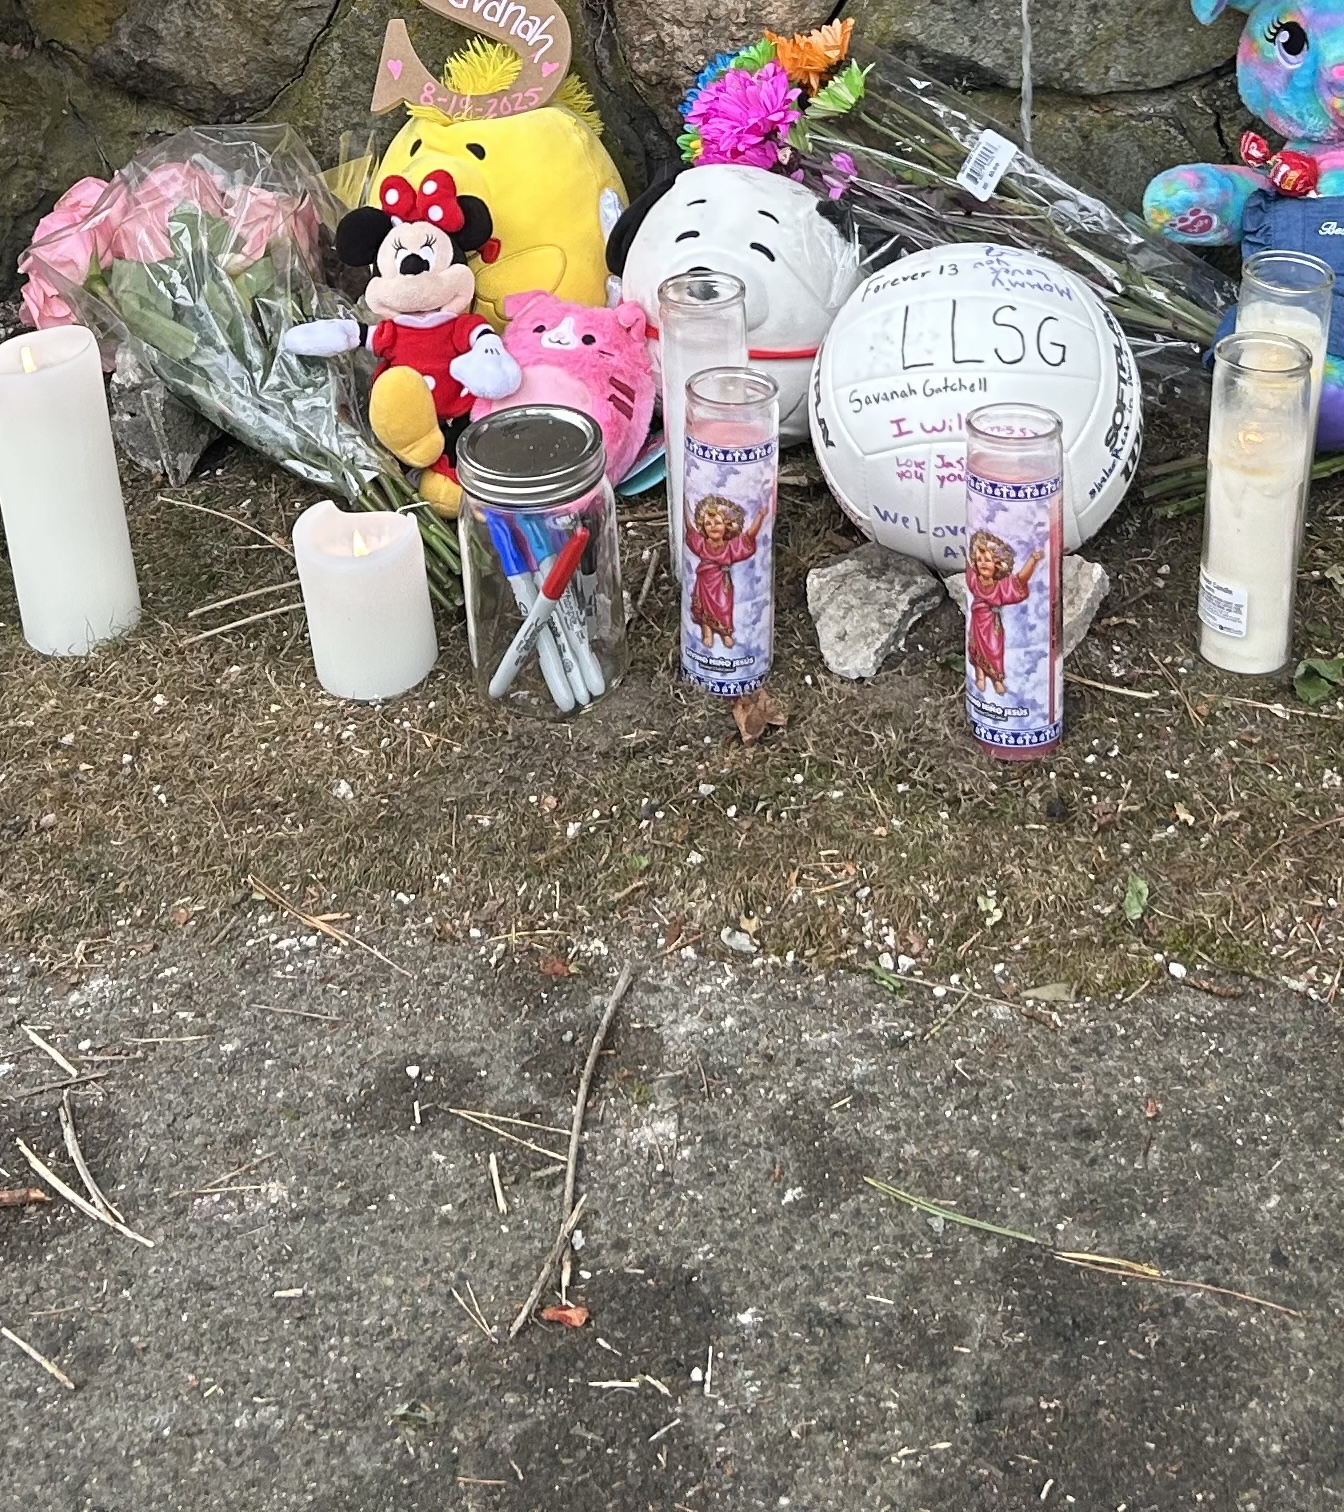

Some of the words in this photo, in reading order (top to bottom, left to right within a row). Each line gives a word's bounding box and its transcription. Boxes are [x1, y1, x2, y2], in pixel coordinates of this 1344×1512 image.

[861, 271, 932, 303] Forever
[938, 263, 960, 276] 13
[848, 382, 918, 414] Savanah
